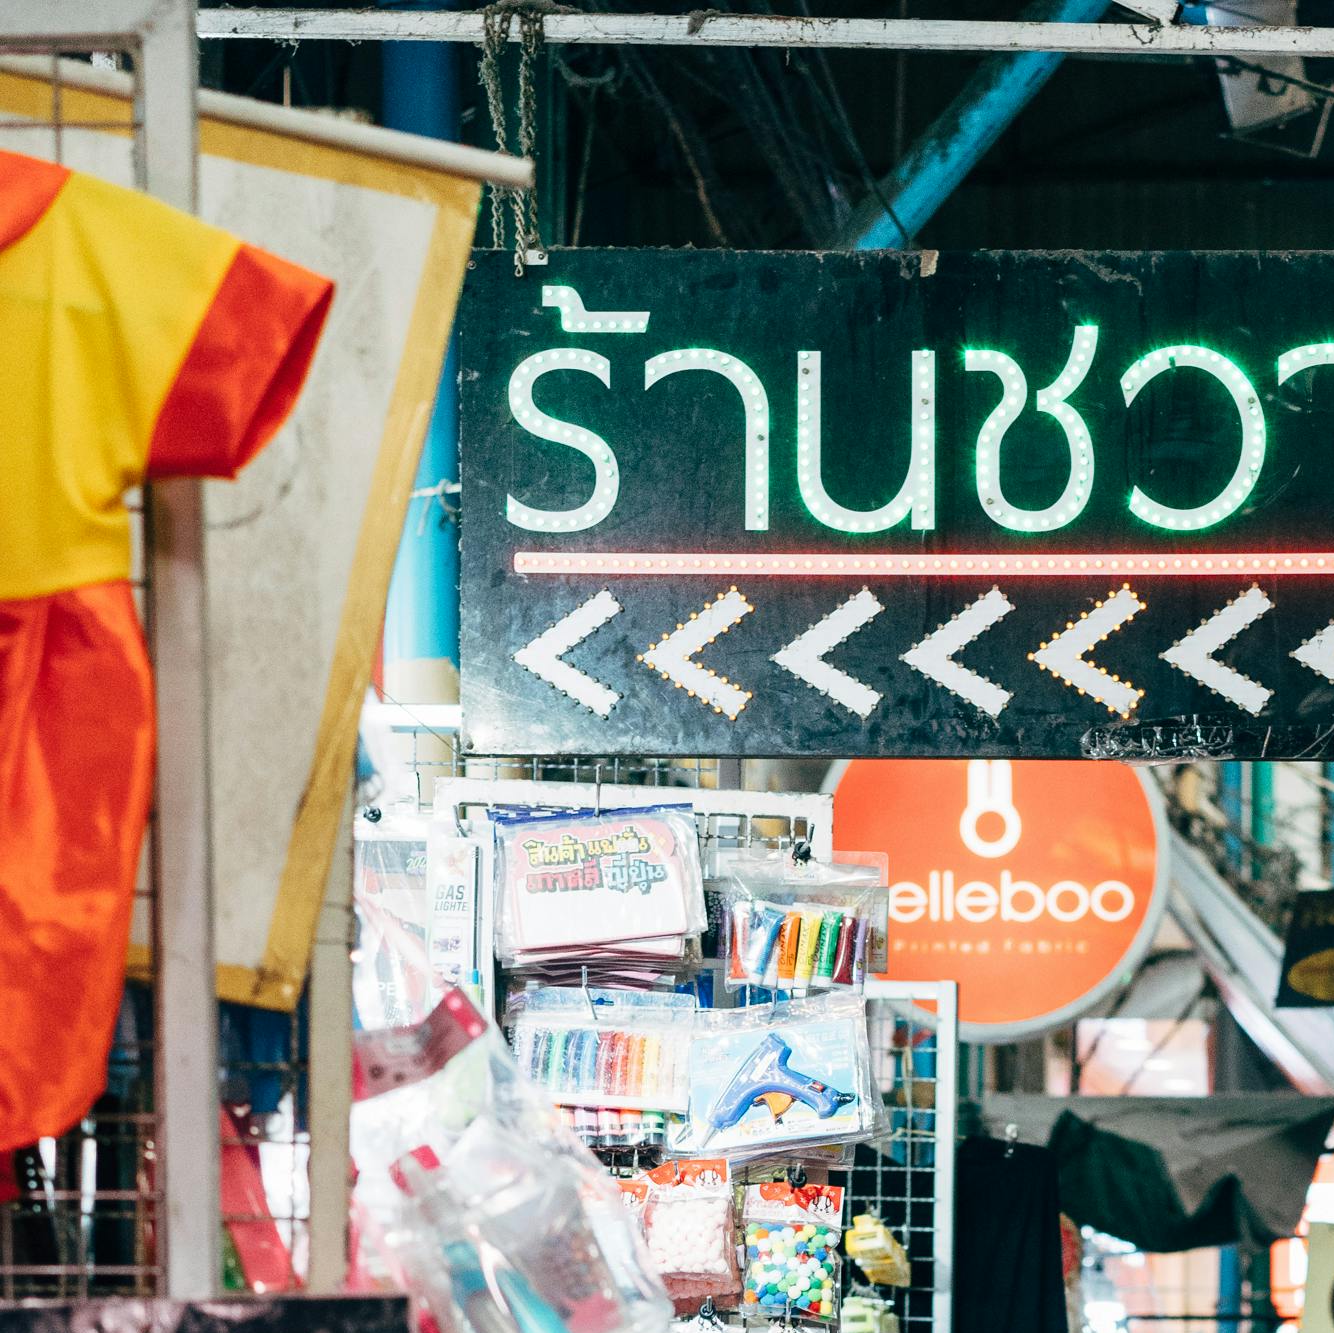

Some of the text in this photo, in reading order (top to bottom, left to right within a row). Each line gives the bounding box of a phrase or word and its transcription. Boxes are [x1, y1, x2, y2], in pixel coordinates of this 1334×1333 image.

[435, 884, 465, 900] GAS
[888, 869, 1136, 924] elleboo
[433, 901, 468, 912] LIGHTE
